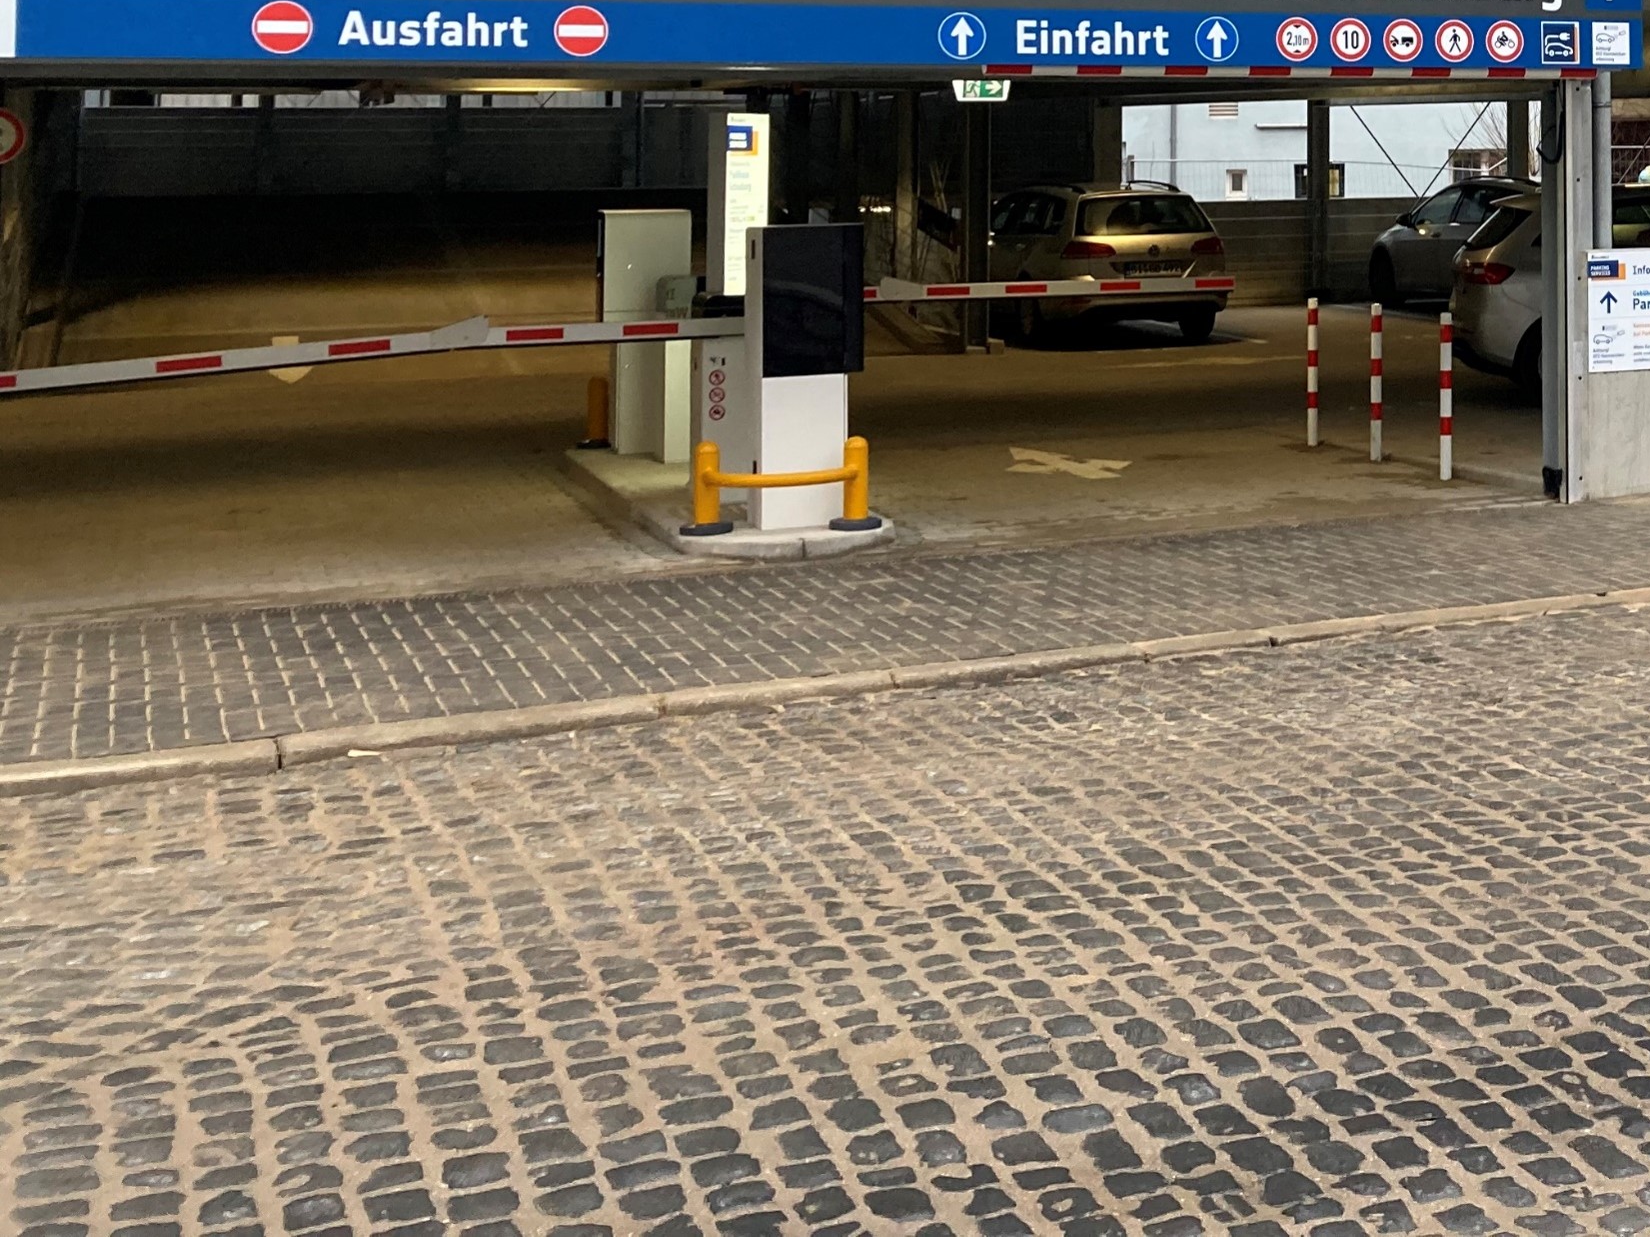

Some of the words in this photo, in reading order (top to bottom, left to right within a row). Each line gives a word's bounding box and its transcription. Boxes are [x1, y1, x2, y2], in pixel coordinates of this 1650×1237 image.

[337, 9, 529, 49] Ausfahrt
[1016, 19, 1170, 56] Einfahrt
[1342, 30, 1360, 49] 10
